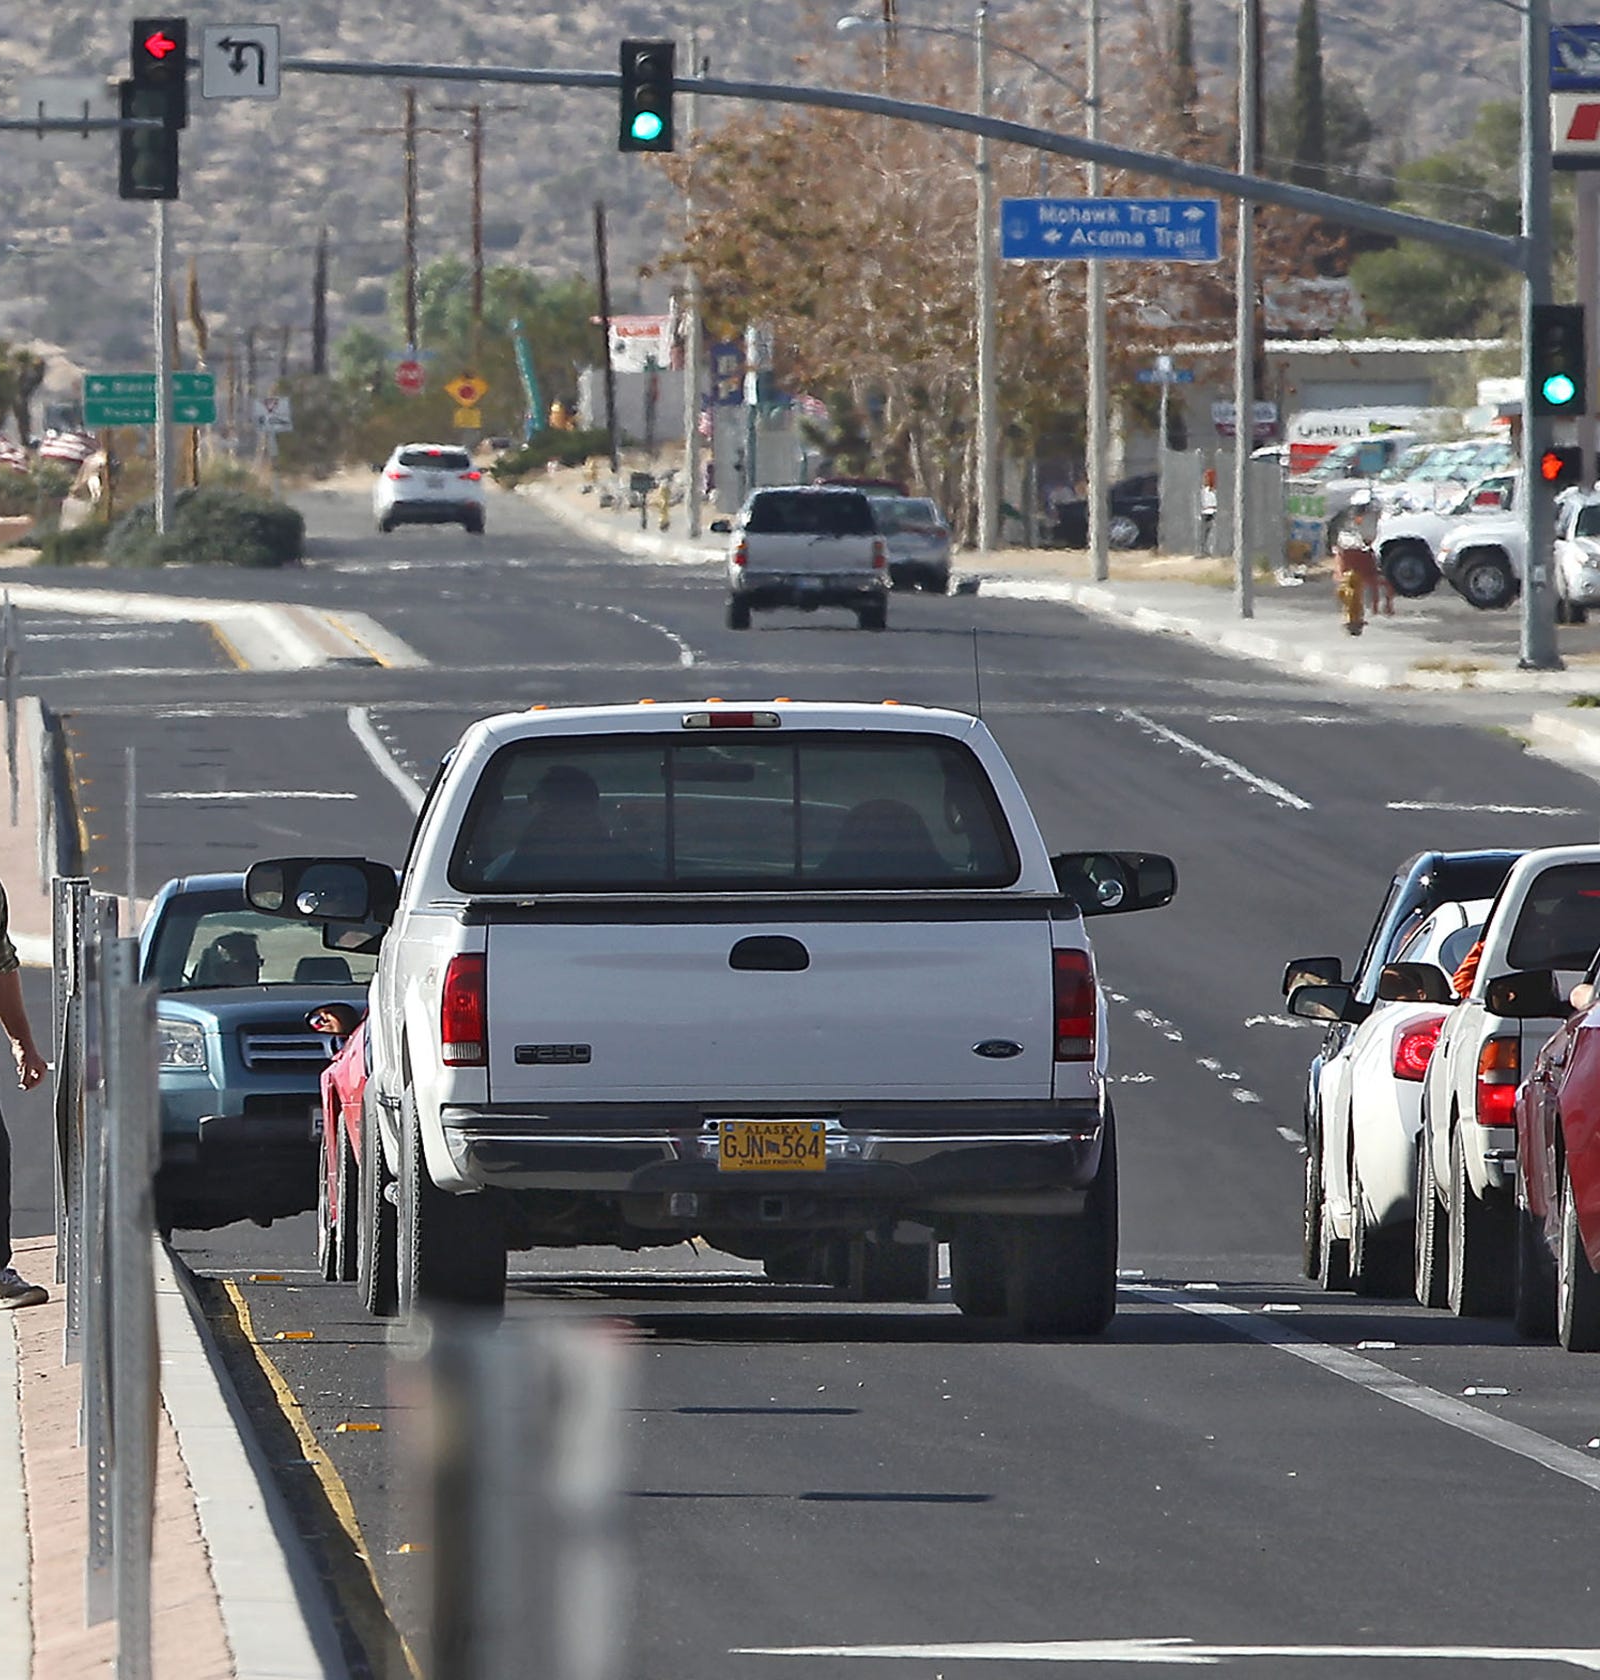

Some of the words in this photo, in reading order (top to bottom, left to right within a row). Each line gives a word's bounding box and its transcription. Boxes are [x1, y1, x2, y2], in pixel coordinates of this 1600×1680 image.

[1039, 204, 1120, 224] Mohawk
[1128, 206, 1171, 223] Trail
[1155, 226, 1201, 247] Trail
[745, 1125, 801, 1135] ALASKA
[724, 1134, 764, 1159] GJN
[782, 1134, 820, 1159] 564
